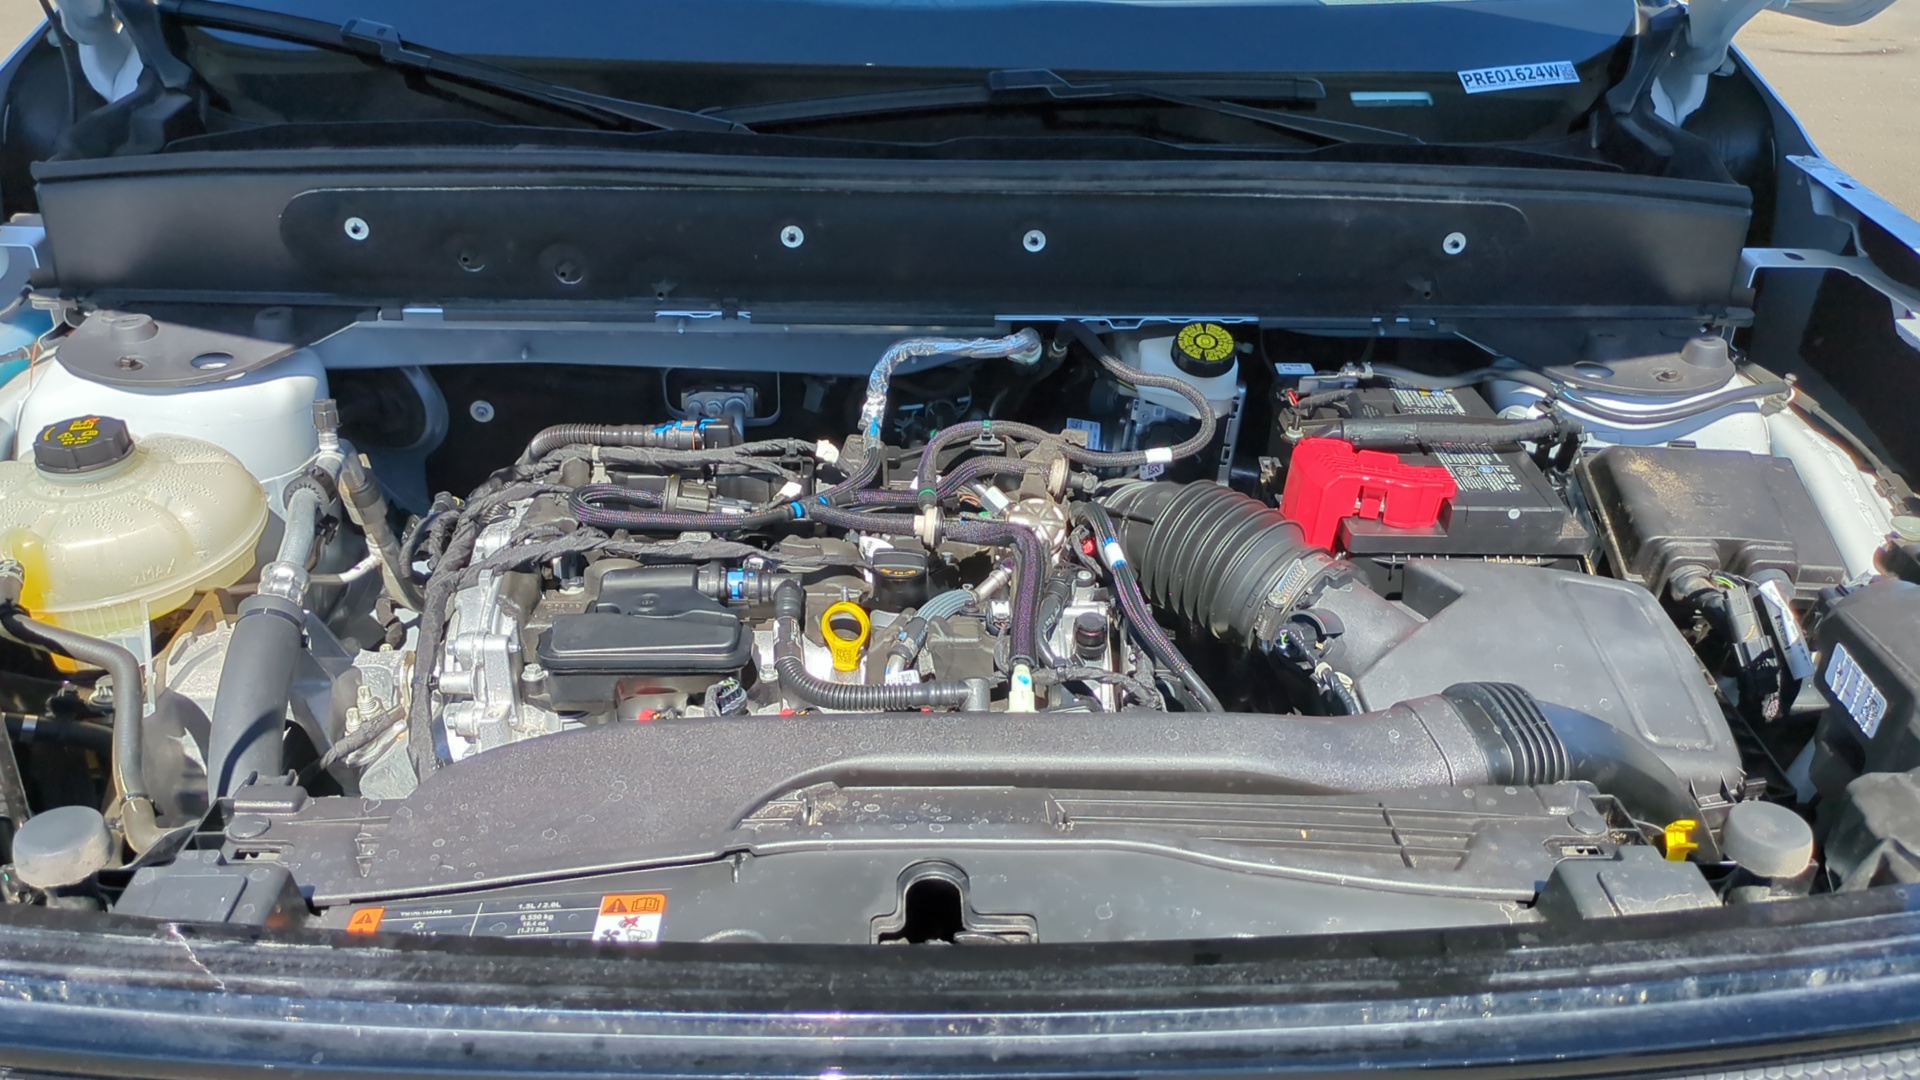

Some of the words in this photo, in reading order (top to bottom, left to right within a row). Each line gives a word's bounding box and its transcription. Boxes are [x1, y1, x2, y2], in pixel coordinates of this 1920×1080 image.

[1461, 64, 1560, 87] PRE01624W
[520, 913, 542, 921] 0.550
[543, 913, 554, 921] kg
